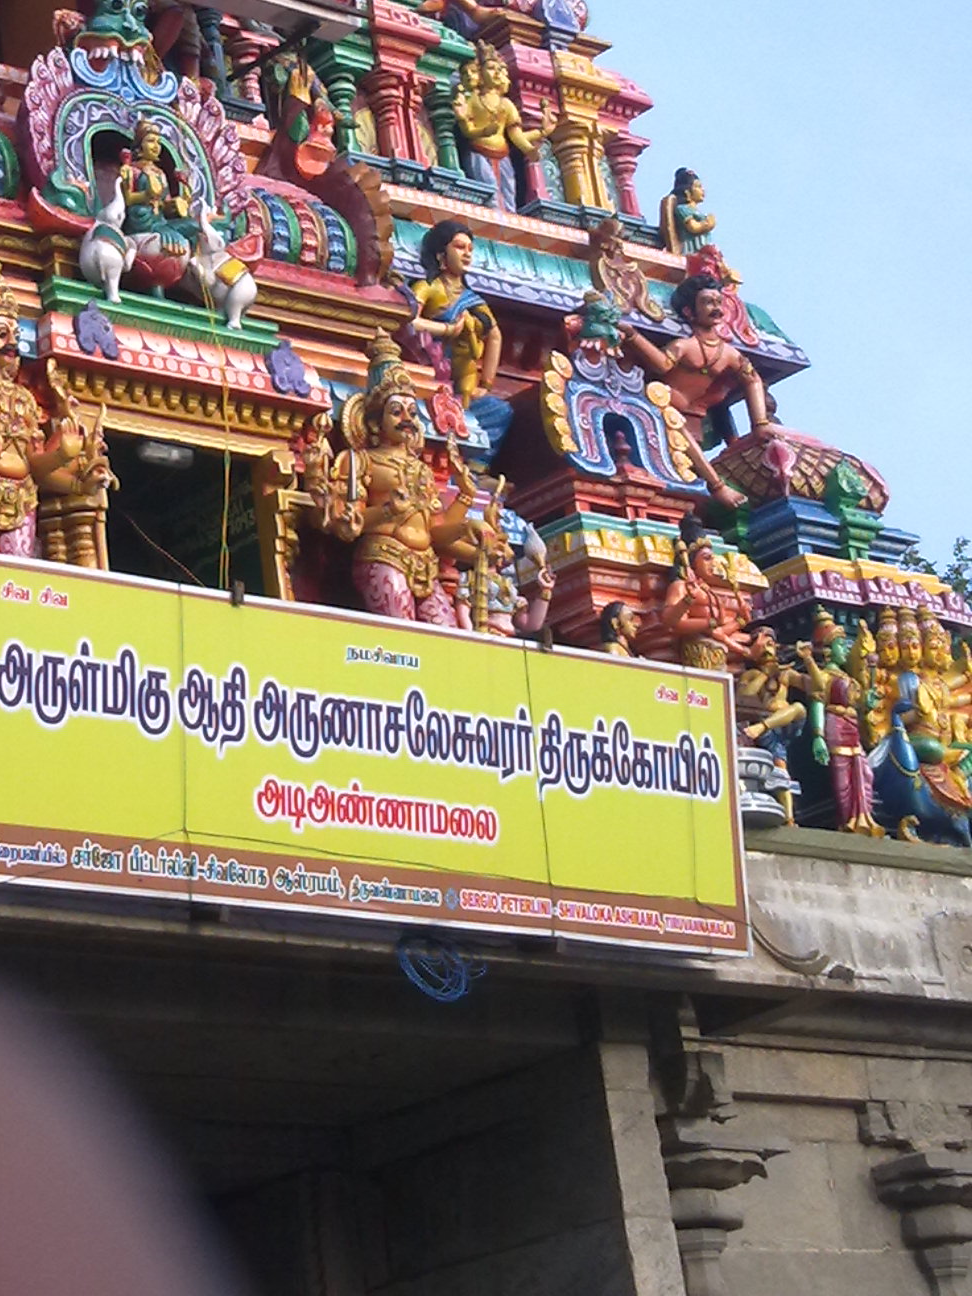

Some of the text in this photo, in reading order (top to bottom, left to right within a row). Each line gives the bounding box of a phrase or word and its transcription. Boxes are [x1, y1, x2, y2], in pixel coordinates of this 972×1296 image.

[346, 646, 420, 668] நமசிவாய
[178, 665, 247, 754] ஆதி
[253, 679, 533, 780] அருணாசலேசுவரர்
[539, 712, 722, 799] திருக்கோயில்
[256, 778, 498, 842] அடிஅண்ணாமலை
[460, 890, 498, 912] SERGIO
[500, 894, 552, 917] PETERLINI
[558, 901, 612, 923] SHIVALOKA
